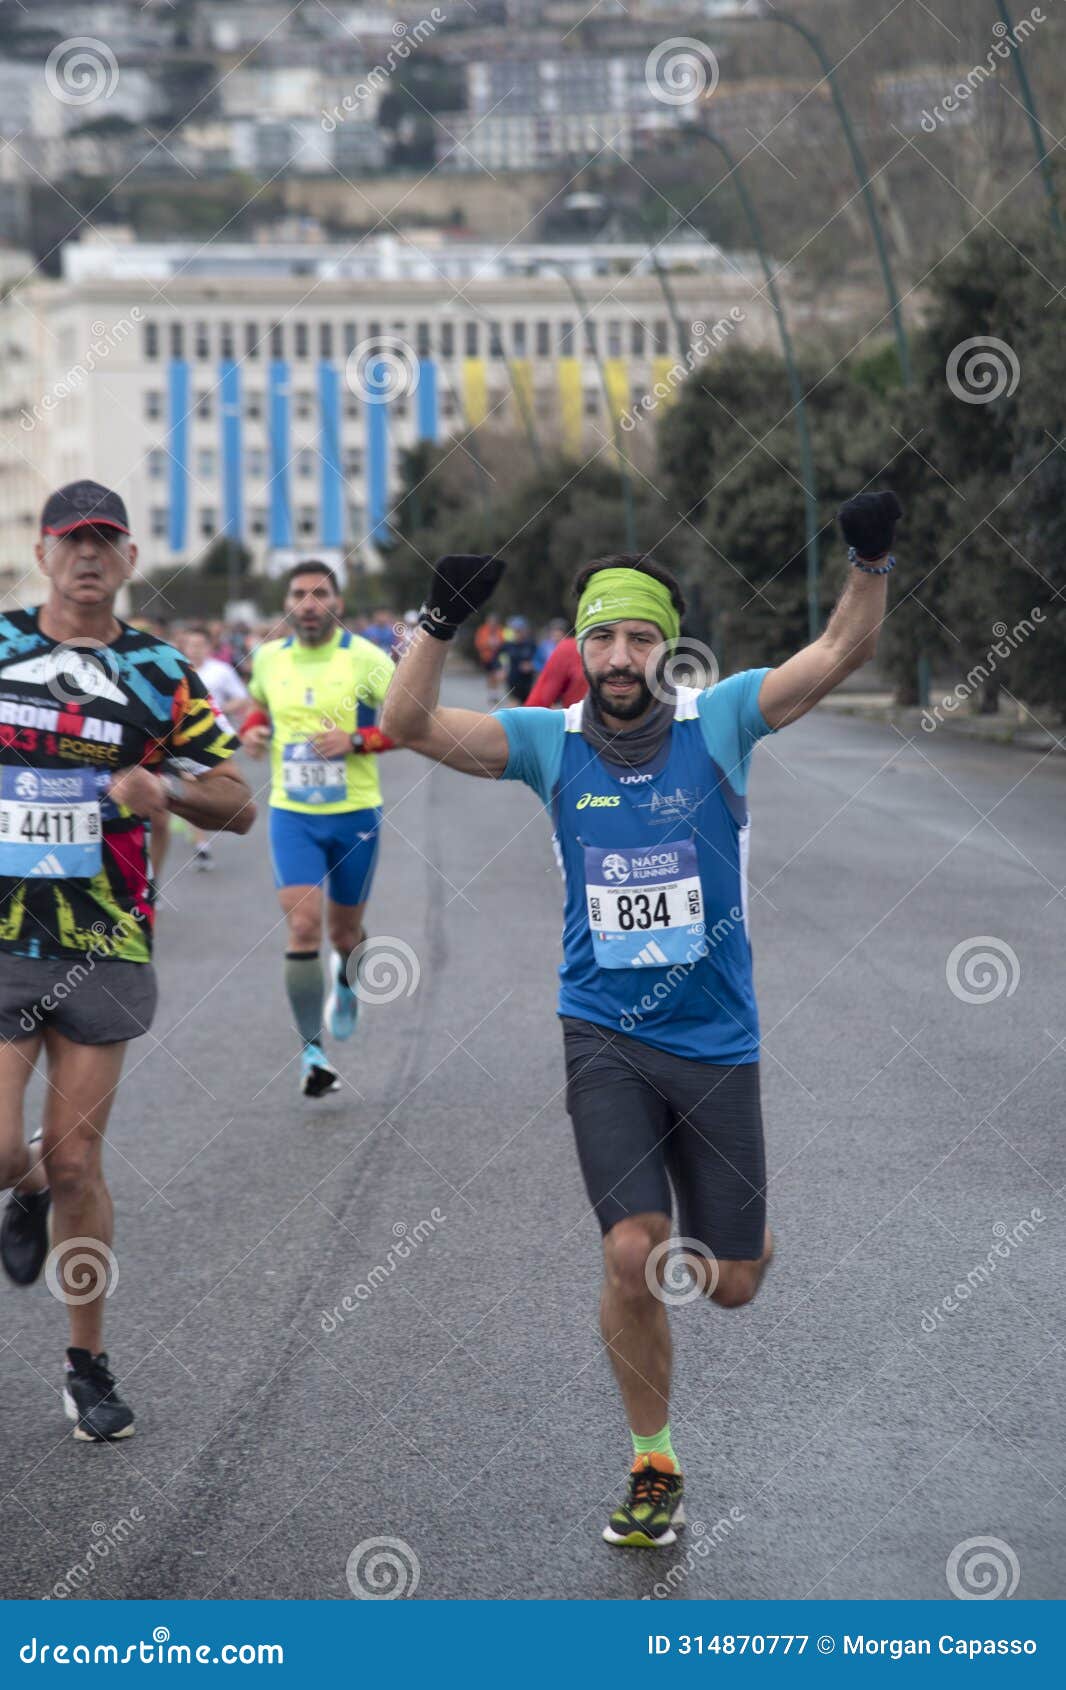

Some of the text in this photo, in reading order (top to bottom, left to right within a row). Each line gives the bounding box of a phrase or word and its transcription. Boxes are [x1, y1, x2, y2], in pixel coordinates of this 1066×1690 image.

[21, 810, 75, 843] 4411
[631, 851, 679, 867] NAPOLI
[632, 865, 680, 879] RUNNING
[616, 891, 672, 931] 834
